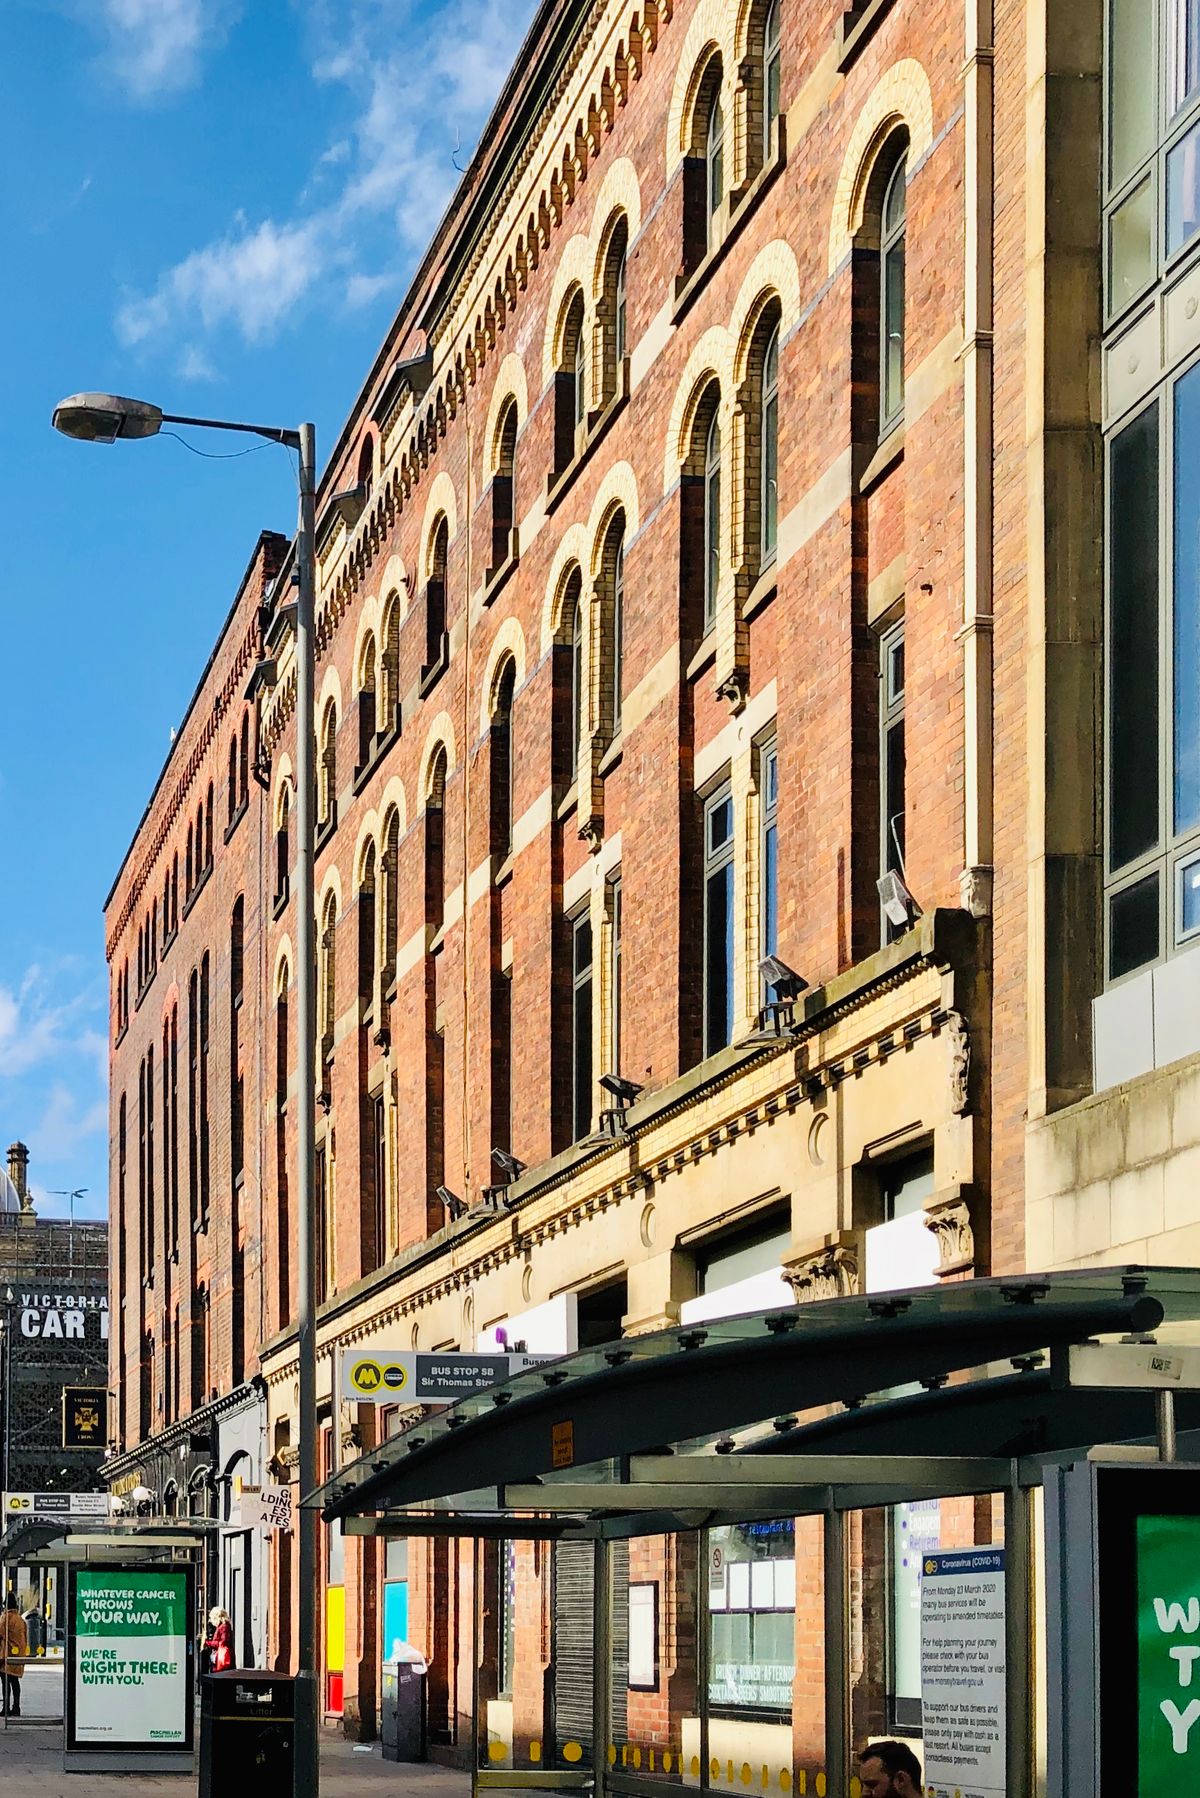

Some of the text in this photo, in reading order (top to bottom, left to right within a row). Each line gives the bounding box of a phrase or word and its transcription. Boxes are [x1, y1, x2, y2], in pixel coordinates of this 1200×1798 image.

[22, 1294, 108, 1308] VICTORIA
[21, 1309, 85, 1338] CAR
[522, 1358, 552, 1366] Buse
[431, 1367, 494, 1376] BUS STOP SB
[421, 1378, 434, 1386] Sir
[436, 1378, 473, 1387] Thomas
[260, 1512, 290, 1527] ATES
[749, 1521, 783, 1534] restaurant
[941, 1556, 1001, 1569] Coronavirus (COVID-19)
[80, 1589, 176, 1600] WHATEVER CANCER
[923, 1586, 936, 1596] From
[937, 1585, 956, 1597] Monday
[964, 1584, 982, 1594] March
[84, 1599, 133, 1610] THROWS
[979, 1598, 986, 1607] be
[82, 1610, 162, 1626] YOUR WAY,
[81, 1649, 117, 1659] WE'RE
[80, 1660, 178, 1674] RIGHT THERE
[82, 1675, 144, 1685] WITH YOU.
